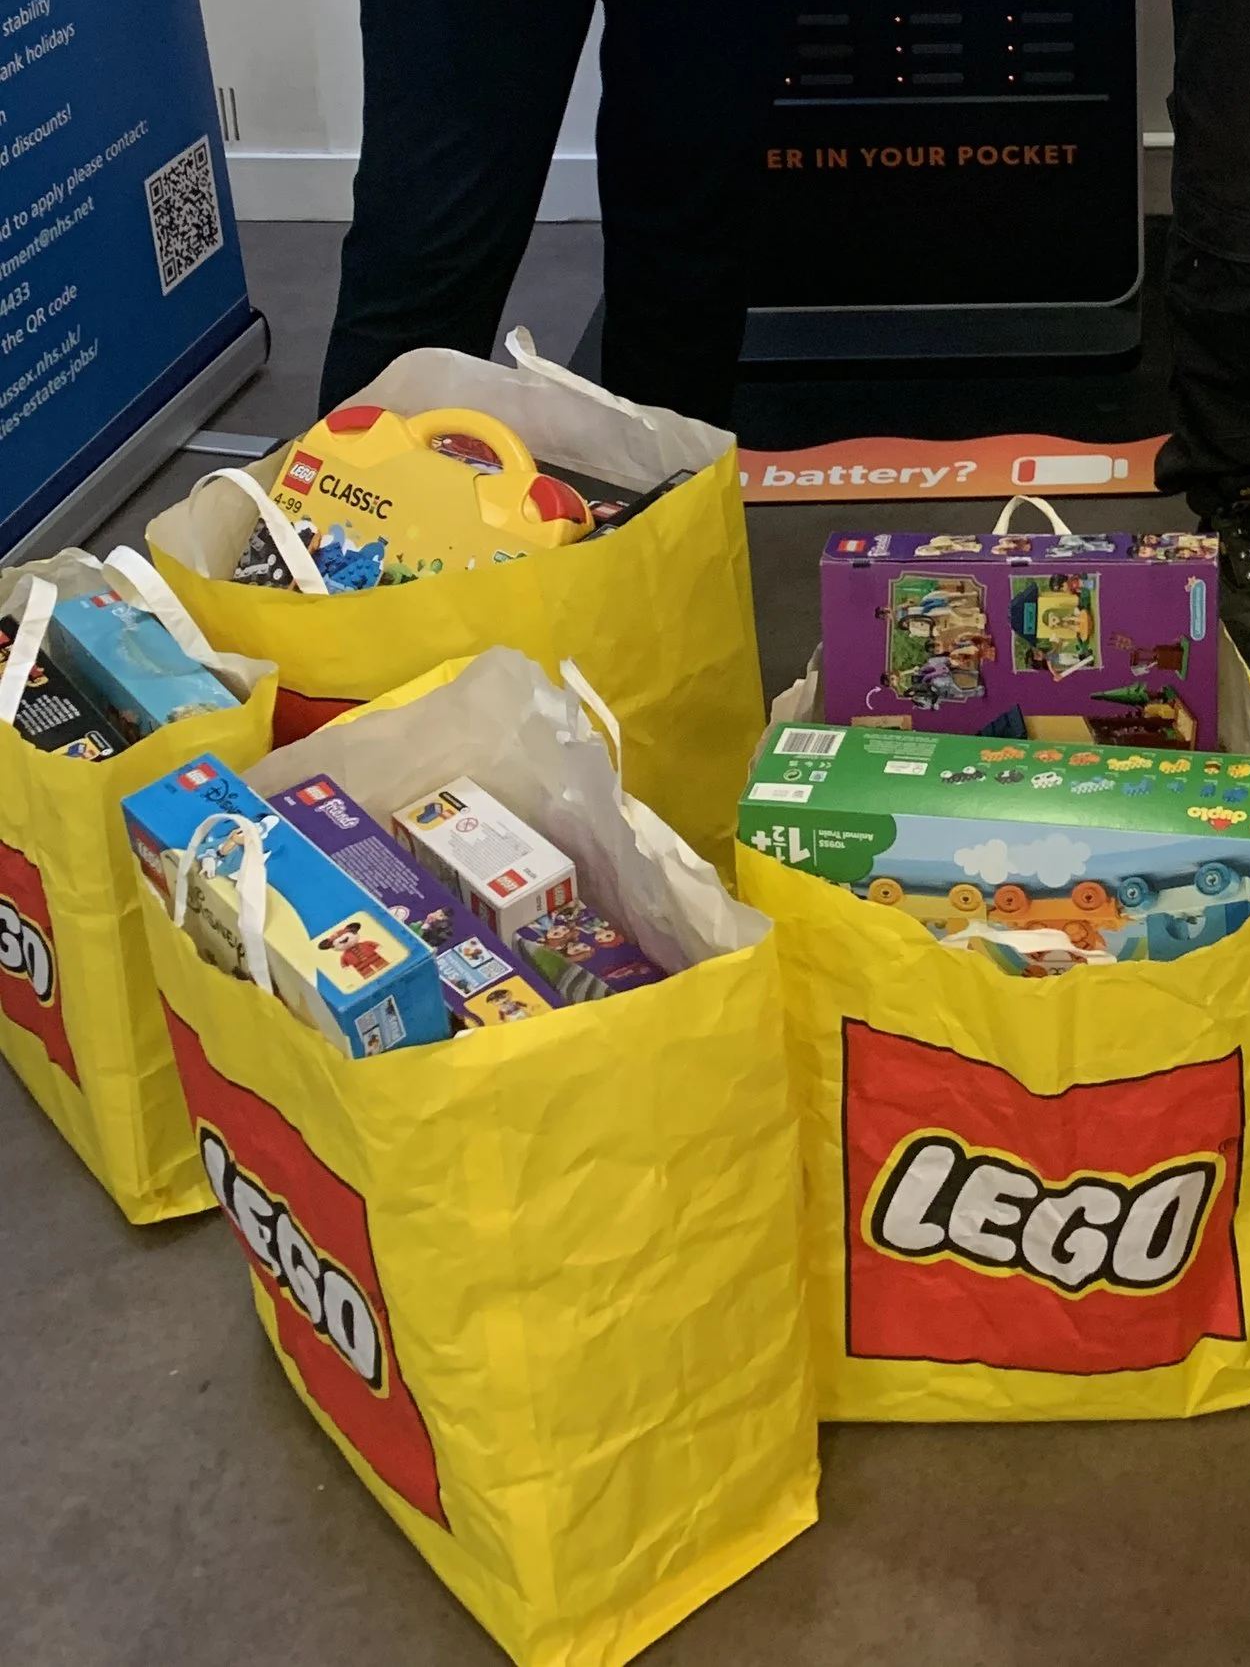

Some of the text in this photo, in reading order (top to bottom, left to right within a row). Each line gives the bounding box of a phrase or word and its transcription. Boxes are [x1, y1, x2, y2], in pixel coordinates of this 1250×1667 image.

[25, 22, 76, 65] holidays
[11, 101, 72, 159] discounts!
[815, 146, 849, 169] IN
[859, 145, 947, 168] YOUR
[957, 143, 1078, 167] POCKET
[13, 211, 29, 230] to
[31, 182, 65, 220] apply
[66, 153, 104, 196] please
[105, 120, 150, 162] contact:
[0, 195, 95, 280] tment@nhs.net
[1, 284, 78, 354] the QR code
[0, 337, 99, 441] ies-estates-jobs/
[273, 492, 303, 514] 4-99
[288, 462, 394, 520] LEGO CLASSIC
[762, 460, 978, 489] battery?
[818, 829, 874, 842] Animal Train
[1187, 806, 1248, 824] duplo
[873, 1137, 1213, 1291] LEGO
[201, 1128, 381, 1388] LEGO
